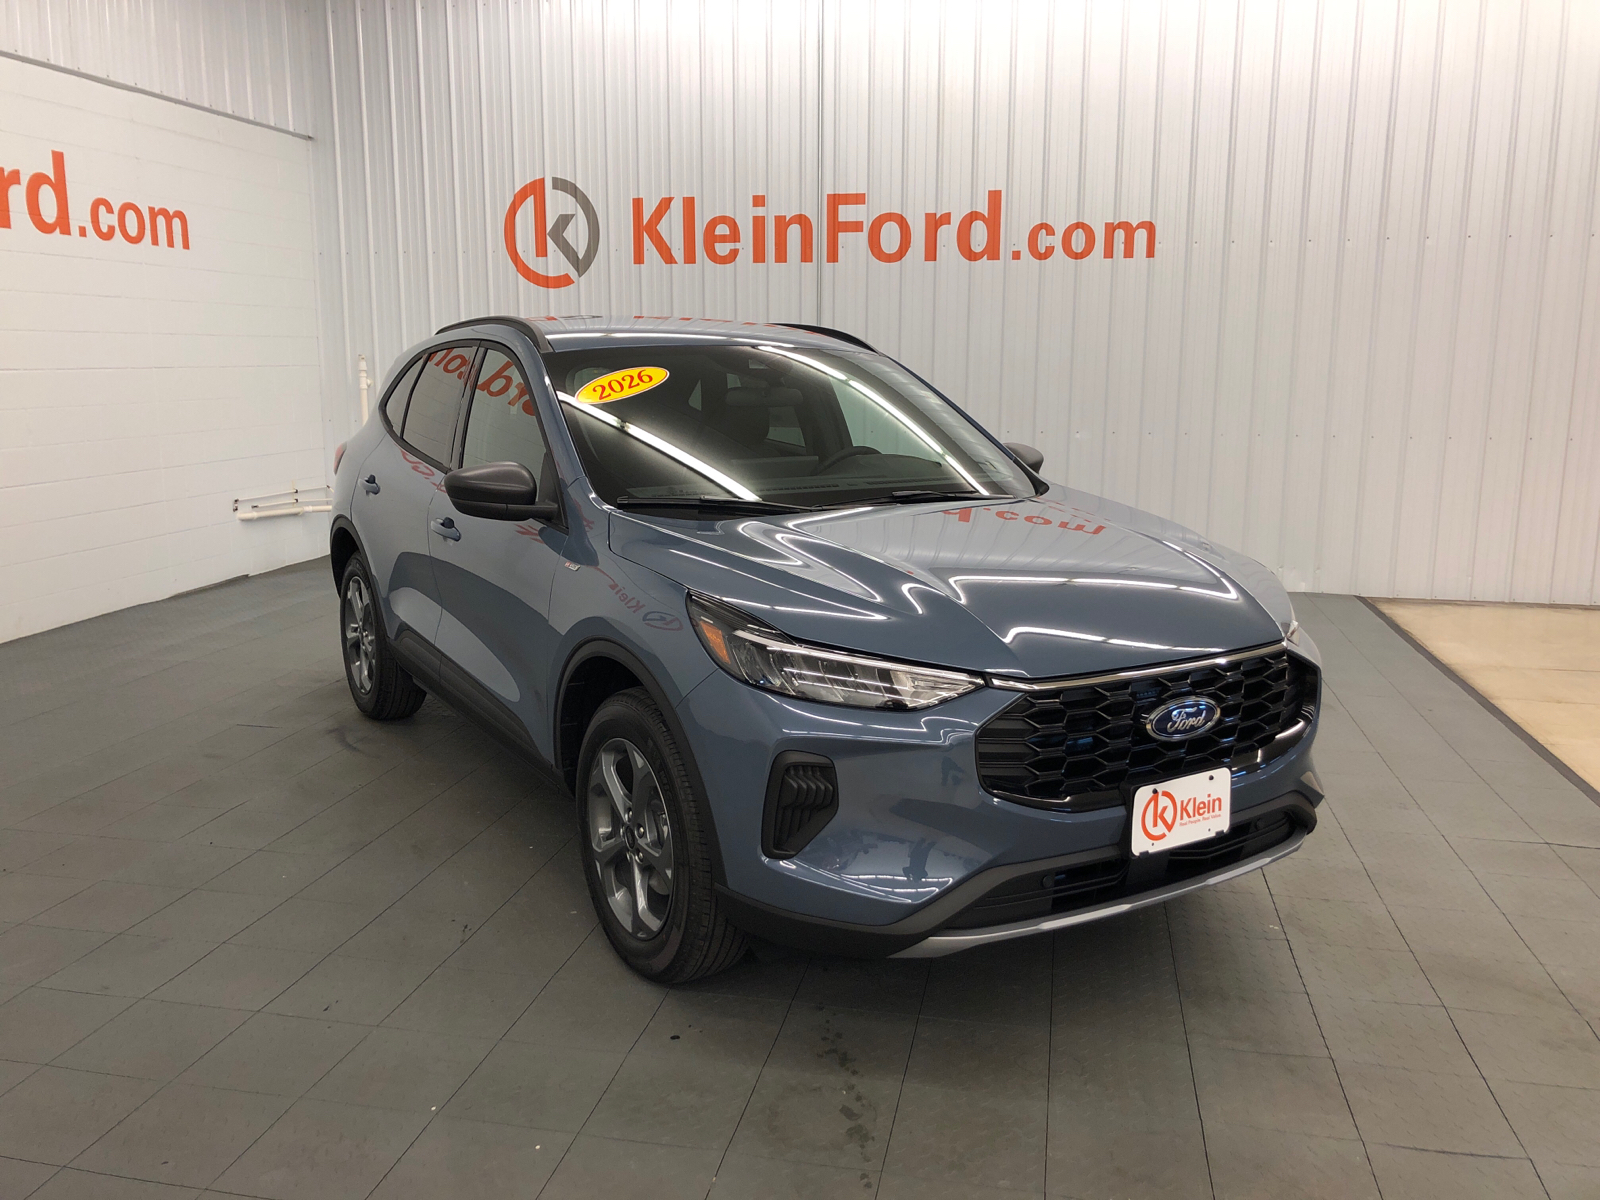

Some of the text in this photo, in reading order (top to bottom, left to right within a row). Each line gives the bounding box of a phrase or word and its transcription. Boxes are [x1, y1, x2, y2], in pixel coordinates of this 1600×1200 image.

[632, 190, 1156, 265] KleinFord.com
[592, 369, 653, 400] 2026
[1166, 706, 1207, 733] Ford
[1180, 793, 1222, 821] Klein
